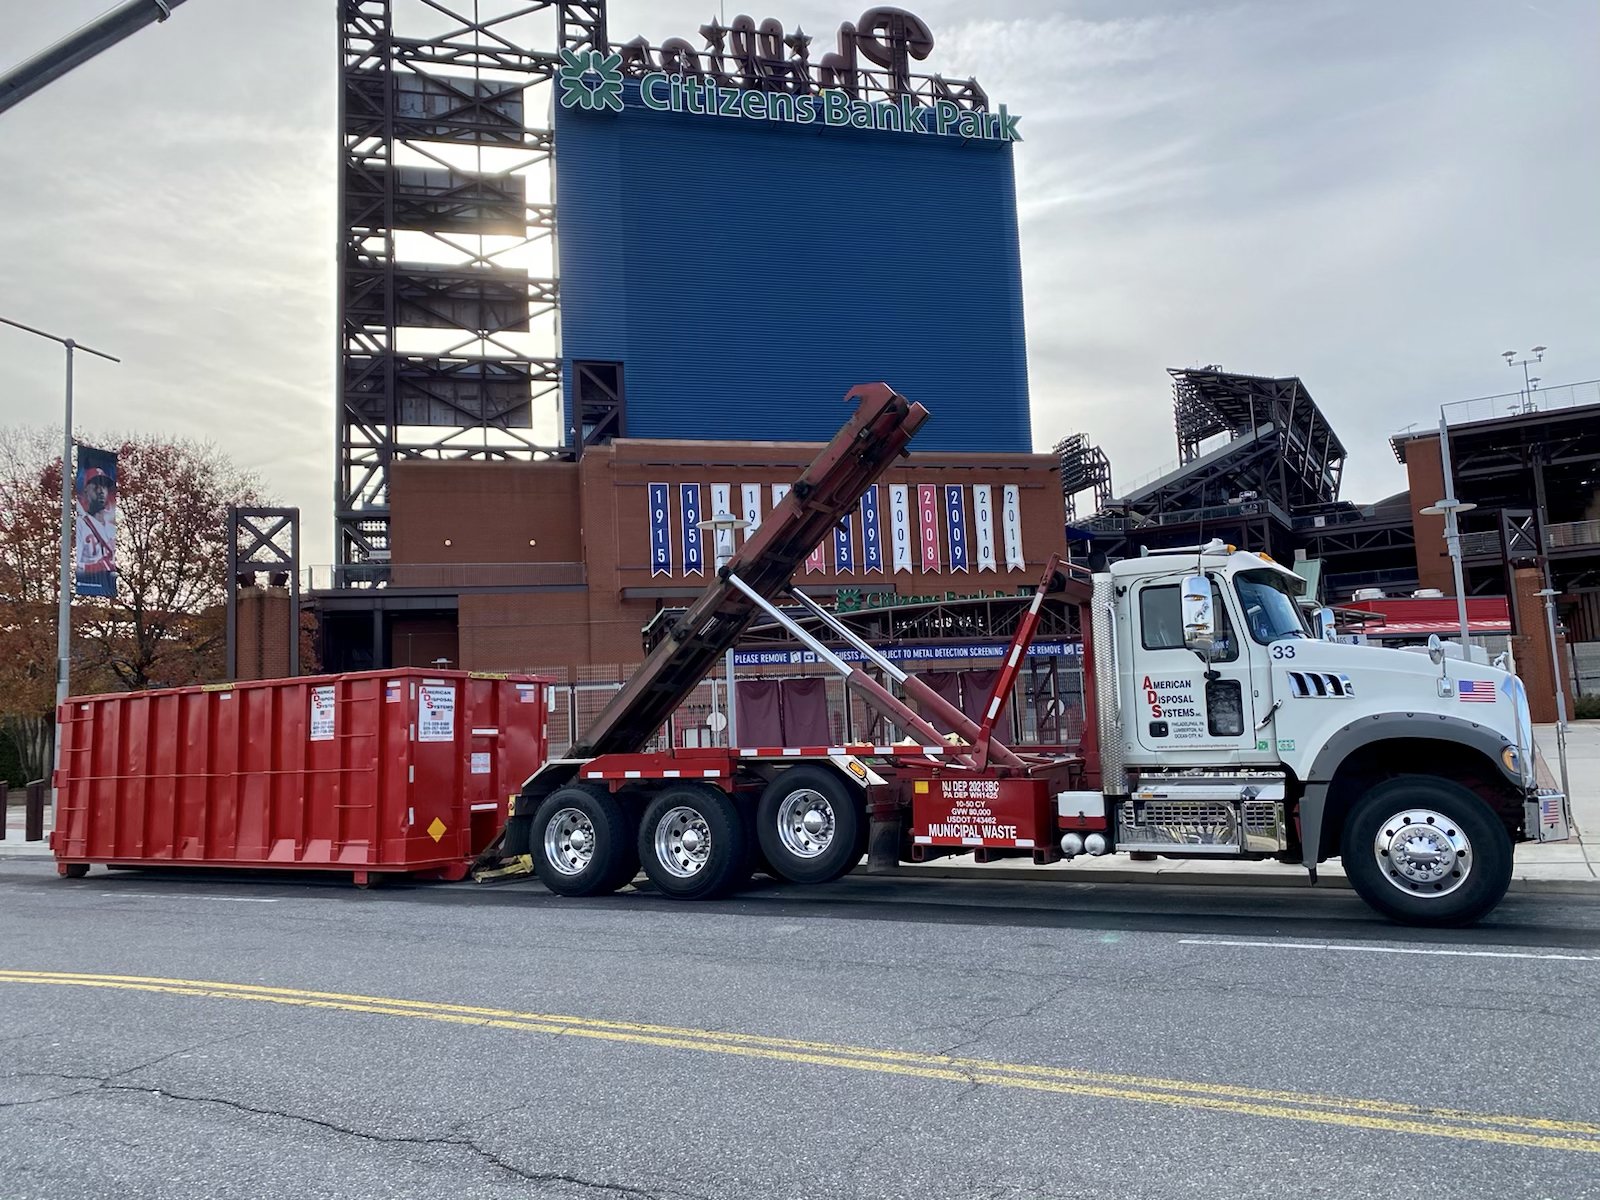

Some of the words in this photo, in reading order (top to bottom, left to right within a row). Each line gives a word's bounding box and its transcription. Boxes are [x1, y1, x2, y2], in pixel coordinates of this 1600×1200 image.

[640, 72, 816, 124] Citizens
[823, 88, 928, 134] Bank
[935, 100, 1024, 142] Park
[655, 489, 666, 563] 1915
[687, 489, 698, 562] 1950
[866, 490, 877, 561] 1993
[895, 490, 905, 560] 2007
[924, 490, 935, 560] 2008
[950, 490, 962, 560] 2009
[980, 490, 989, 559] 2010
[1007, 490, 1017, 559] 2011
[734, 653, 759, 664] PLEASE
[760, 653, 787, 663] REMOVE
[903, 649, 911, 659] TO
[913, 649, 933, 658] METAL
[934, 648, 968, 658] DETECTION
[969, 646, 1003, 657] SCREENING
[1036, 645, 1061, 655] REMOVE
[1272, 645, 1296, 660] 33
[1143, 676, 1191, 690] AMERICAN
[1147, 690, 1194, 705] DISPOSAL
[1152, 704, 1195, 718] SYSTEMS
[941, 780, 952, 792] NJ
[953, 780, 968, 792] DEP
[943, 791, 954, 799] PA
[954, 791, 969, 799] DEP
[951, 807, 968, 816] GVW
[956, 800, 974, 808] 10-50
[974, 800, 986, 808] CY
[946, 815, 971, 824] USDOT
[928, 823, 981, 838] MUNICIPAL
[982, 825, 1017, 839] WASTE
